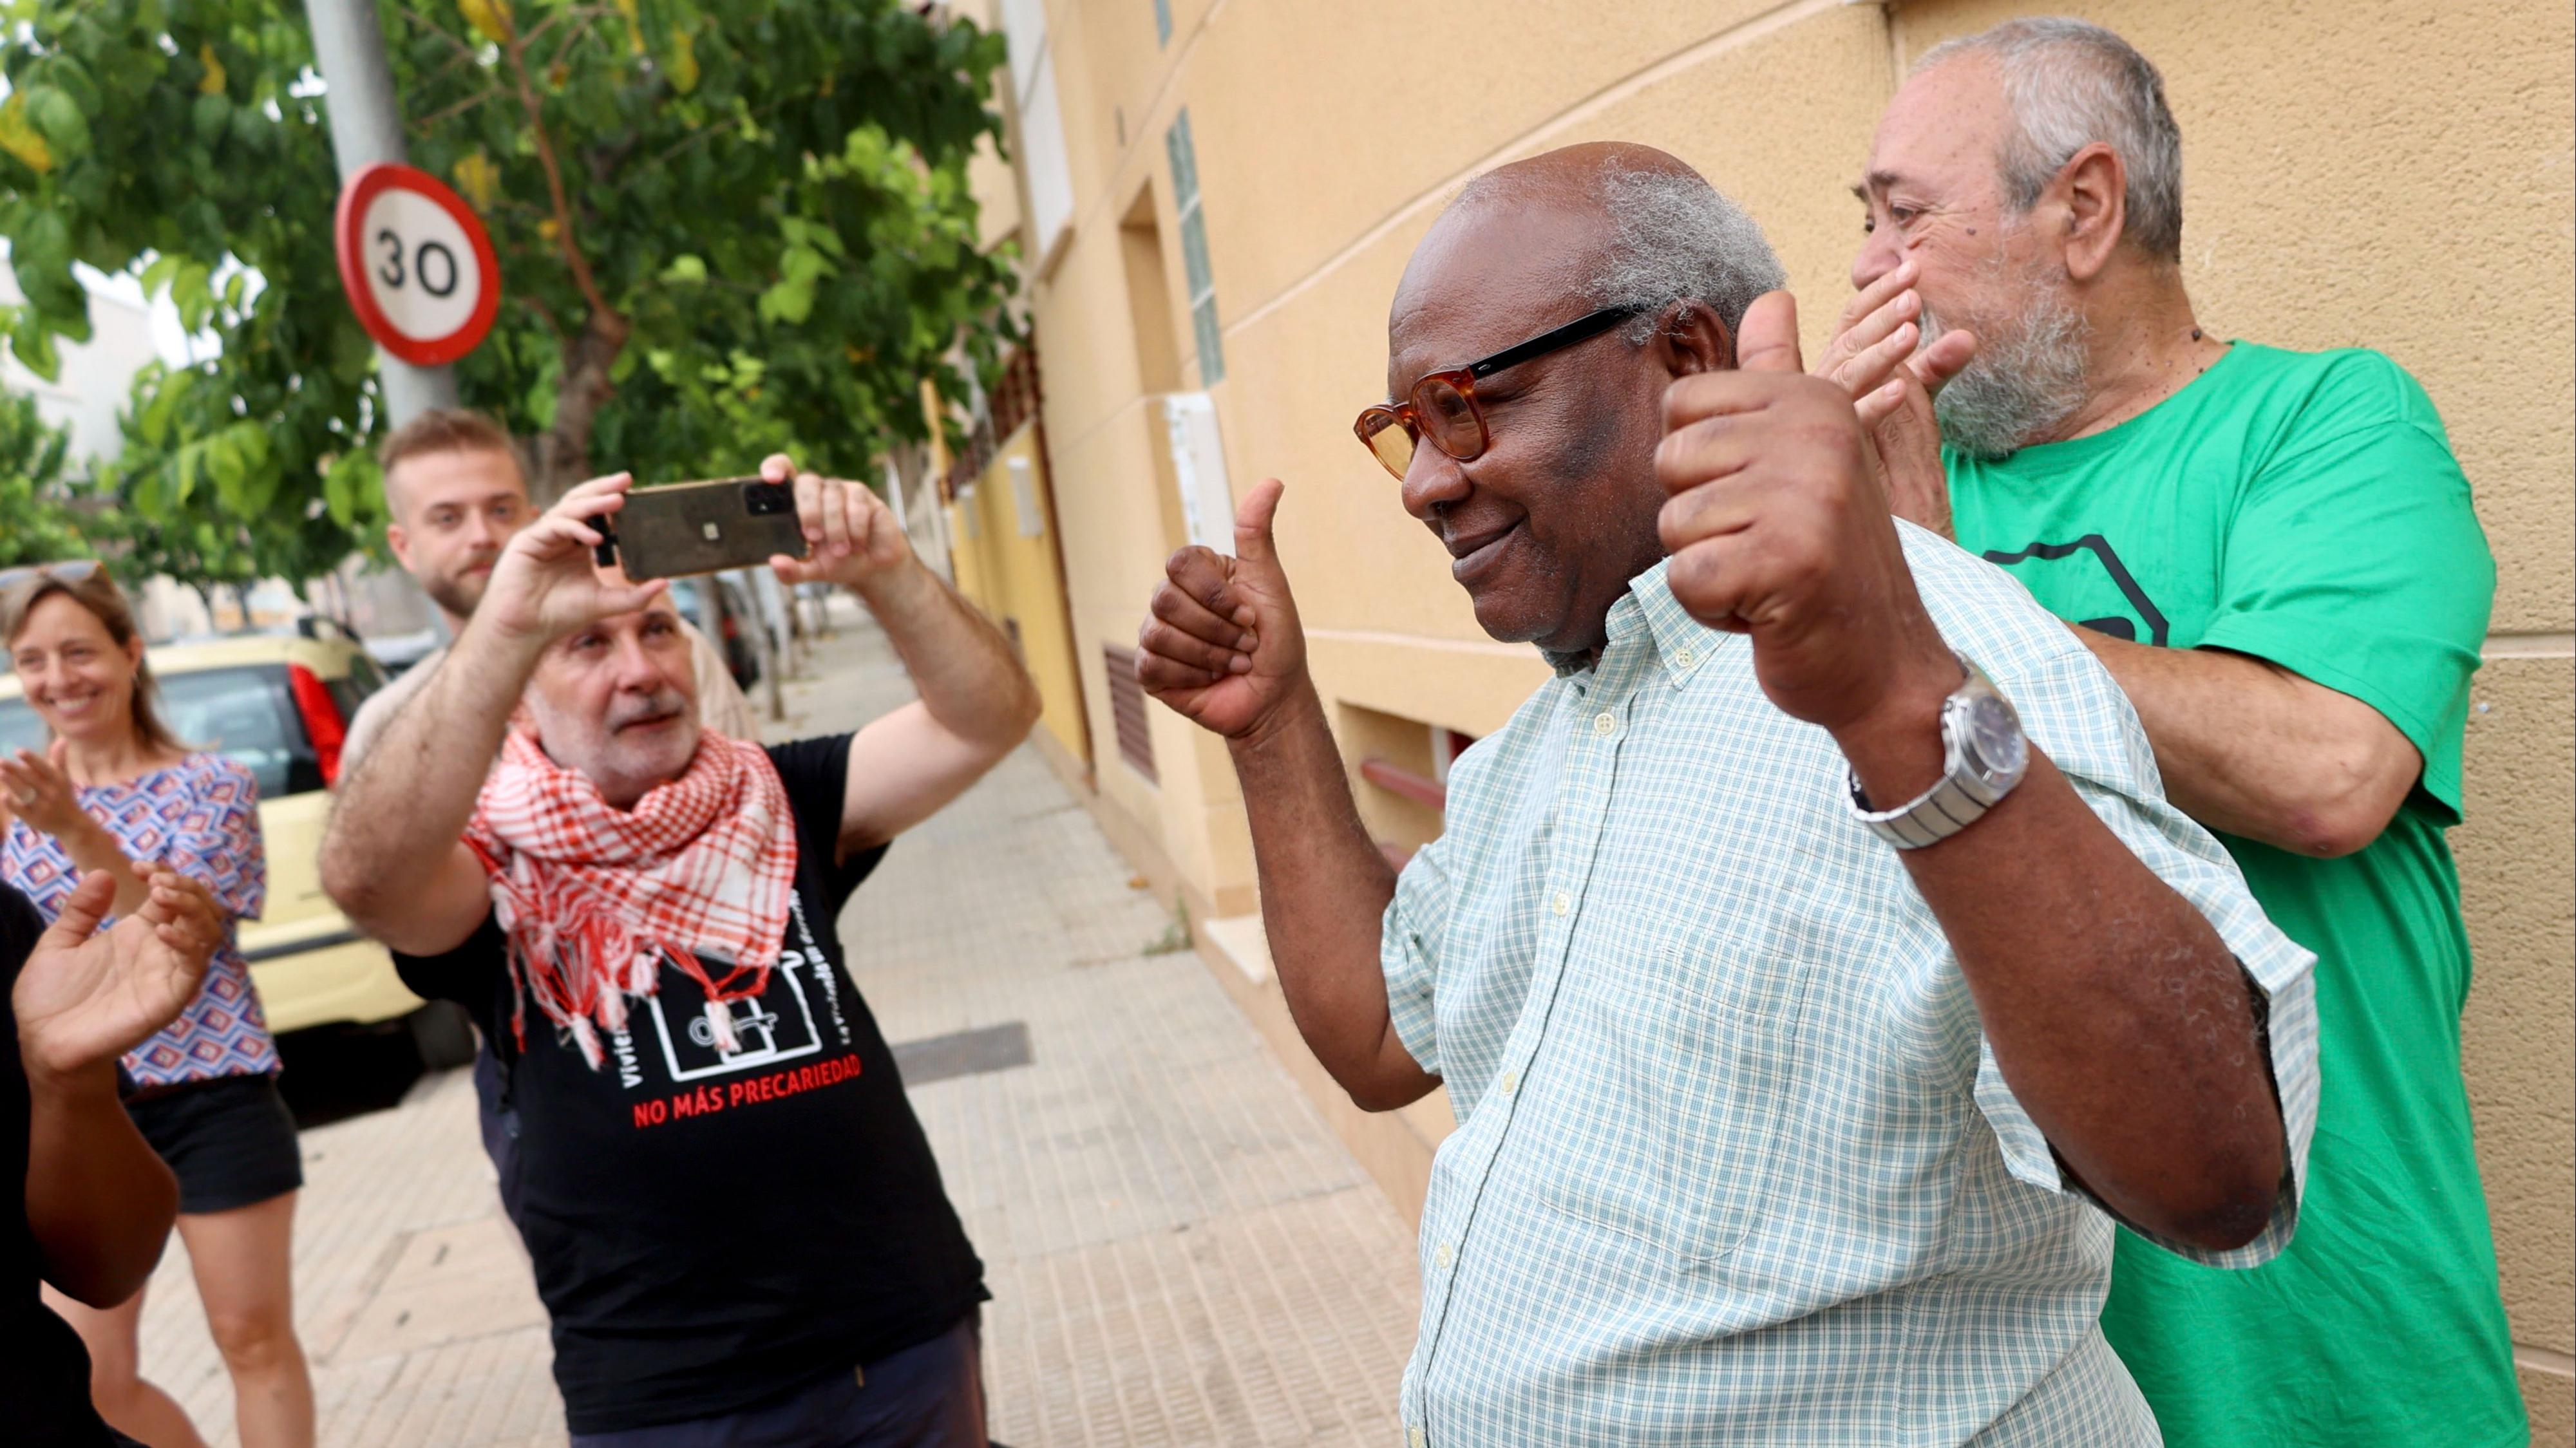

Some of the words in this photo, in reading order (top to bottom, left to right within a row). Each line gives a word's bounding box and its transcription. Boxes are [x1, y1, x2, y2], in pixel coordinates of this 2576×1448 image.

[377, 228, 459, 299] 30
[613, 1028, 643, 1089] Vivie
[632, 1099, 668, 1129] NO
[672, 1084, 725, 1120] MÁS
[730, 1053, 862, 1107] PRECARIEDAD
